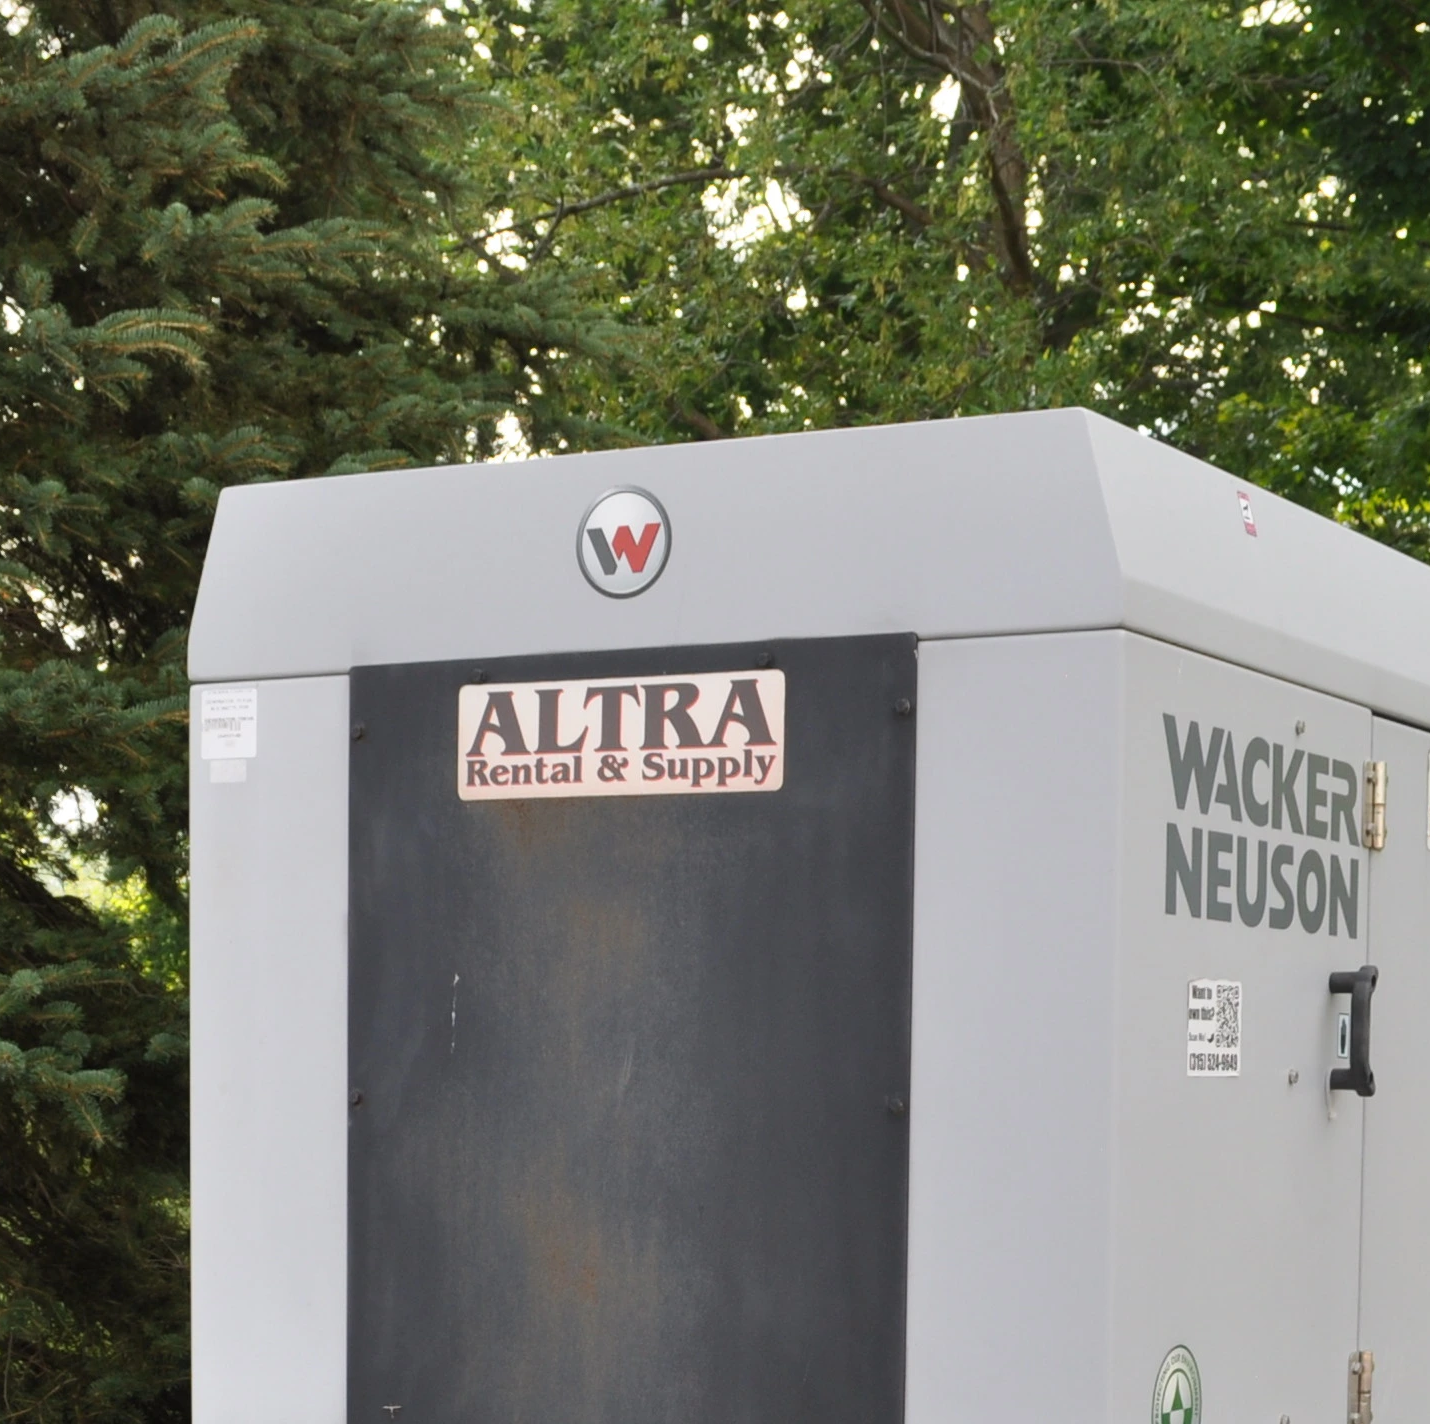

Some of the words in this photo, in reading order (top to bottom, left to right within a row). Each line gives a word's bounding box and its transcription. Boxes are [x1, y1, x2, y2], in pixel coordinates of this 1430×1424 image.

[466, 679, 777, 758] ALTRA
[466, 755, 582, 787] Rental
[596, 754, 628, 783] &
[641, 749, 777, 787] Supply
[1162, 712, 1360, 847] WACKER
[1164, 822, 1360, 940] NEUSON
[1189, 1052, 1207, 1071] (315)
